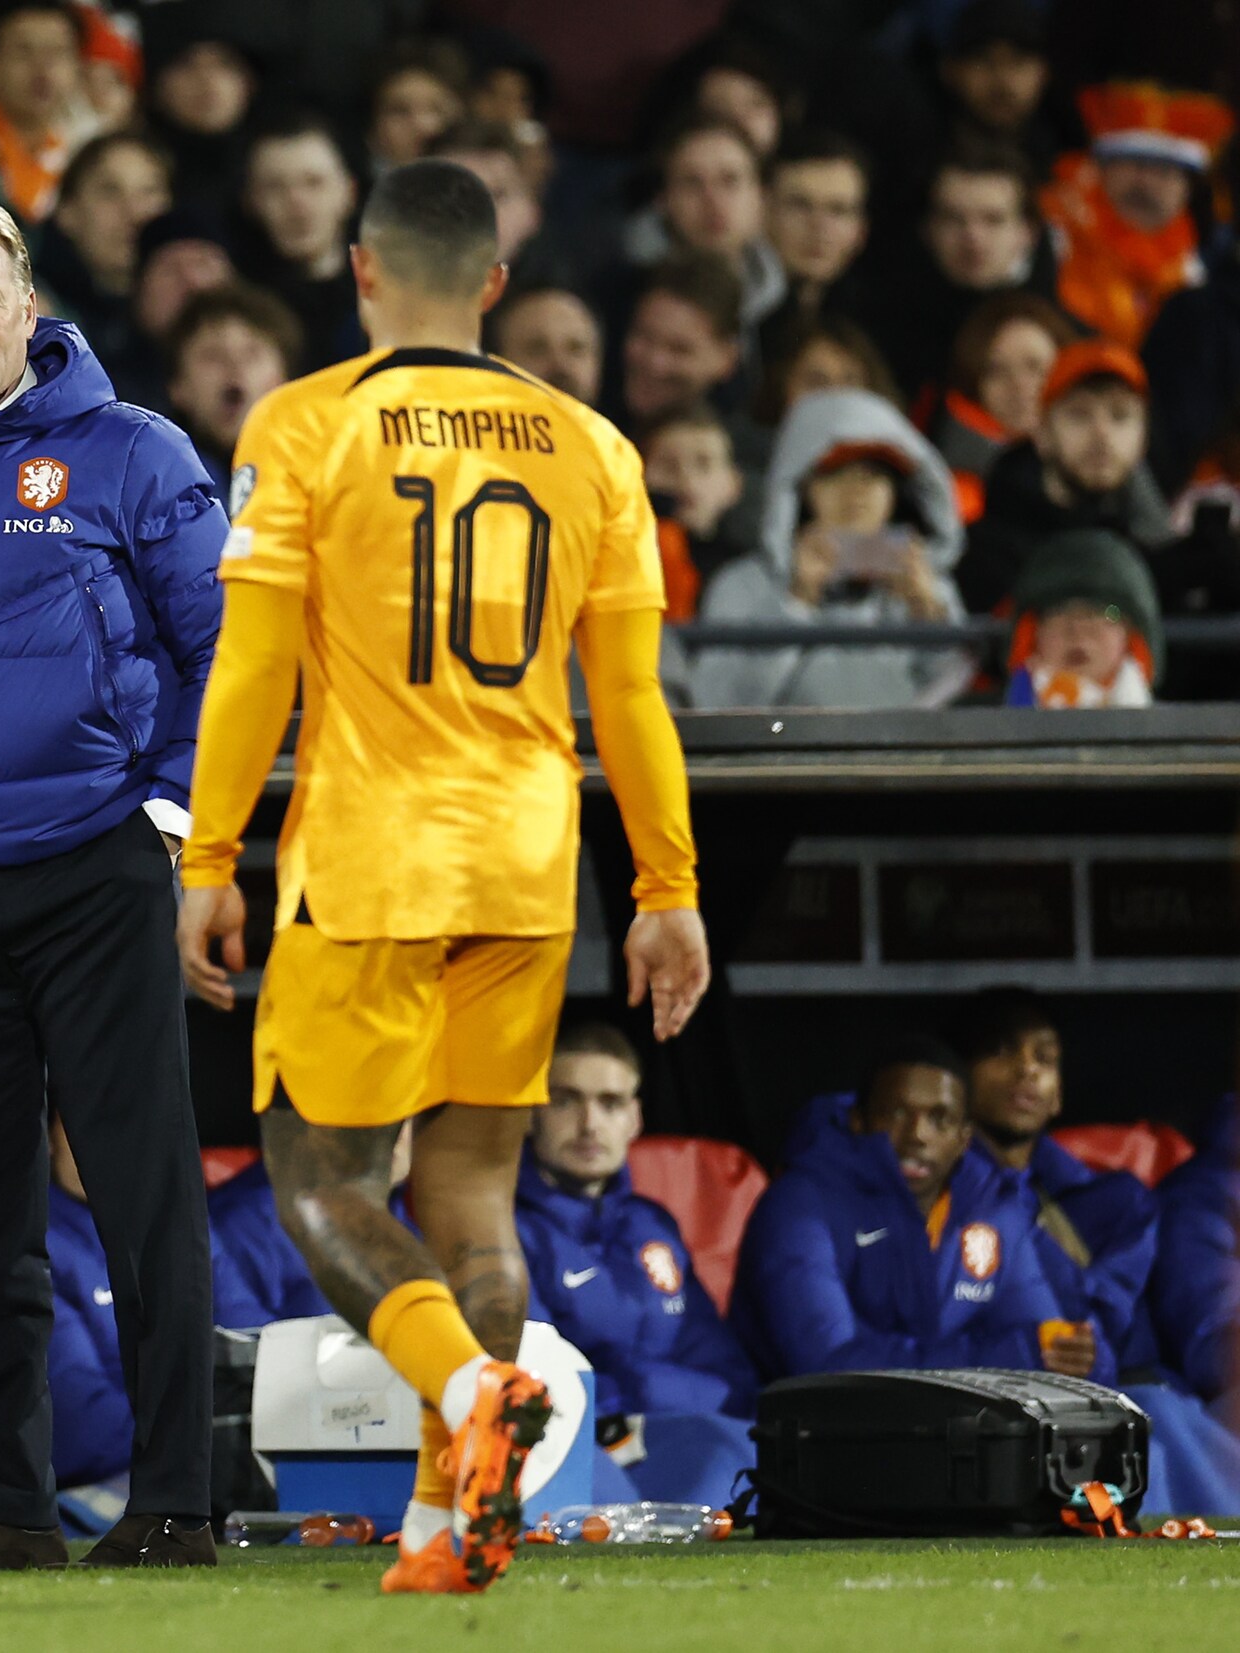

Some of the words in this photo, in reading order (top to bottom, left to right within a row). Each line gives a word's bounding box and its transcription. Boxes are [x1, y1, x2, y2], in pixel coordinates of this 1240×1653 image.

[379, 407, 555, 455] MEMPHIS
[2, 518, 45, 534] ING
[392, 475, 551, 688] 10
